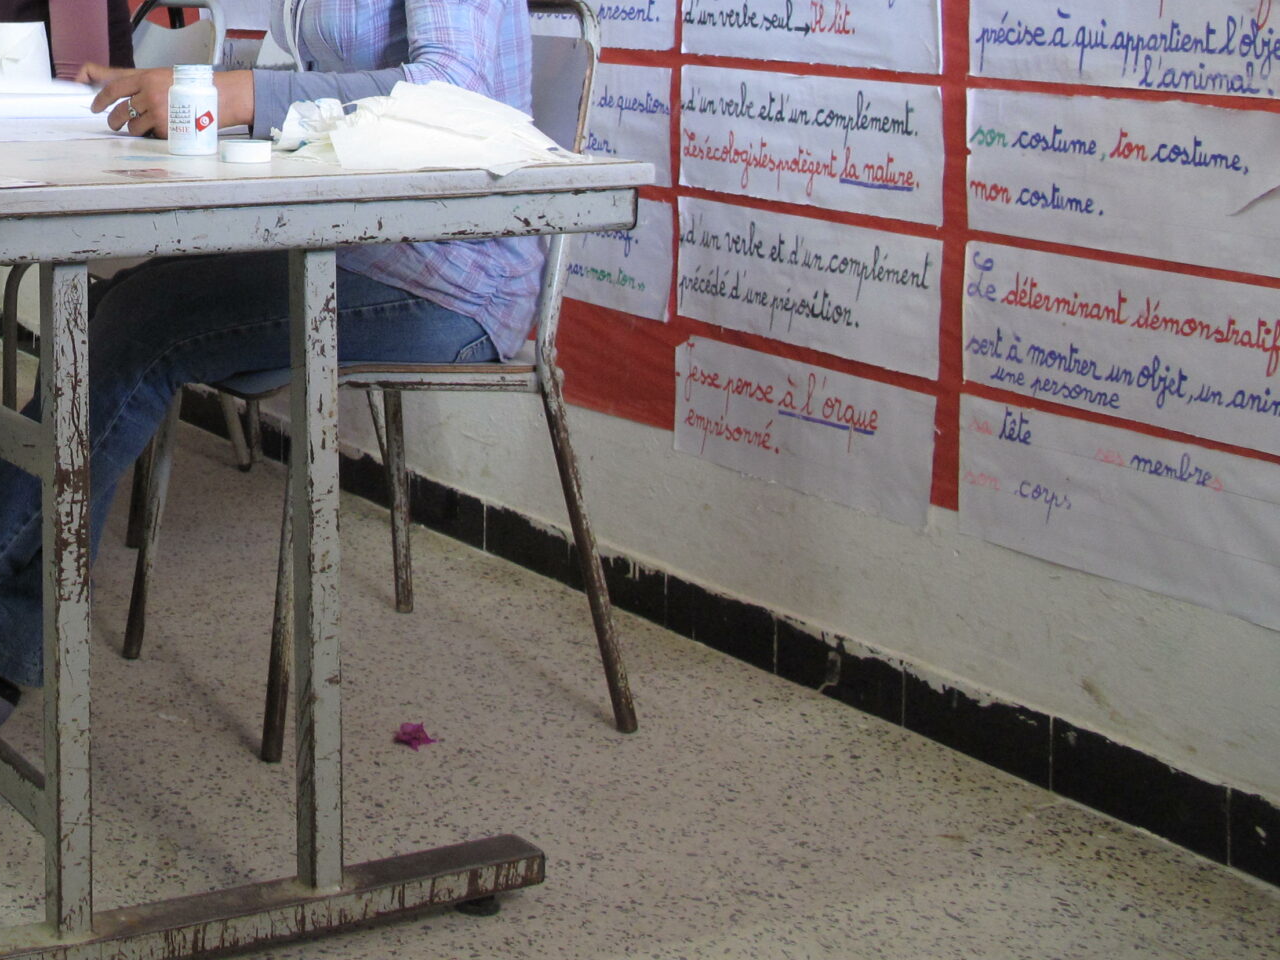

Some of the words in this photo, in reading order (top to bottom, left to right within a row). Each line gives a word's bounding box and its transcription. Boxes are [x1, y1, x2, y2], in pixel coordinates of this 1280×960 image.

[720, 3, 758, 28] verbe
[828, 0, 856, 35] lit.
[975, 10, 1046, 74] précise
[1049, 7, 1070, 48] à
[1072, 19, 1108, 76] qui
[1110, 19, 1216, 77] appartient
[1138, 55, 1274, 96] l'animal.
[597, 84, 614, 108] de
[617, 90, 670, 127] questions
[685, 89, 717, 116] d'un
[720, 82, 756, 119] verbe
[758, 92, 775, 121] et
[775, 93, 810, 125] d'un
[776, 145, 837, 197] protègent
[840, 145, 859, 180] la
[863, 152, 920, 187] nature.
[970, 125, 1007, 147] son
[1110, 128, 1148, 160] ton
[1151, 135, 1249, 176] costume,
[970, 179, 1011, 204] mon
[685, 214, 721, 251] d'un
[725, 221, 765, 258] verbe
[768, 233, 785, 264] et
[787, 235, 824, 272] d'un
[824, 244, 932, 302] complément
[679, 266, 727, 309] précédé
[727, 269, 769, 307] d'une
[770, 288, 860, 333] préposition.
[967, 250, 997, 301] Le
[1000, 272, 1128, 324] déterminant
[1130, 297, 1280, 377] démonstratif
[965, 326, 1003, 359] sert
[1006, 332, 1023, 363] à
[1027, 342, 1101, 381] montrer
[1106, 364, 1134, 386] un
[1137, 355, 1194, 408] objet,
[1193, 383, 1223, 406] un
[991, 365, 1024, 388] une
[1030, 375, 1120, 409] personne
[685, 409, 780, 454] emprisonné.
[723, 377, 774, 416] pense
[778, 375, 798, 411] à
[800, 373, 879, 453] l'orque
[999, 408, 1031, 446] tête
[1130, 453, 1224, 492] membres
[1016, 480, 1071, 524] corps
